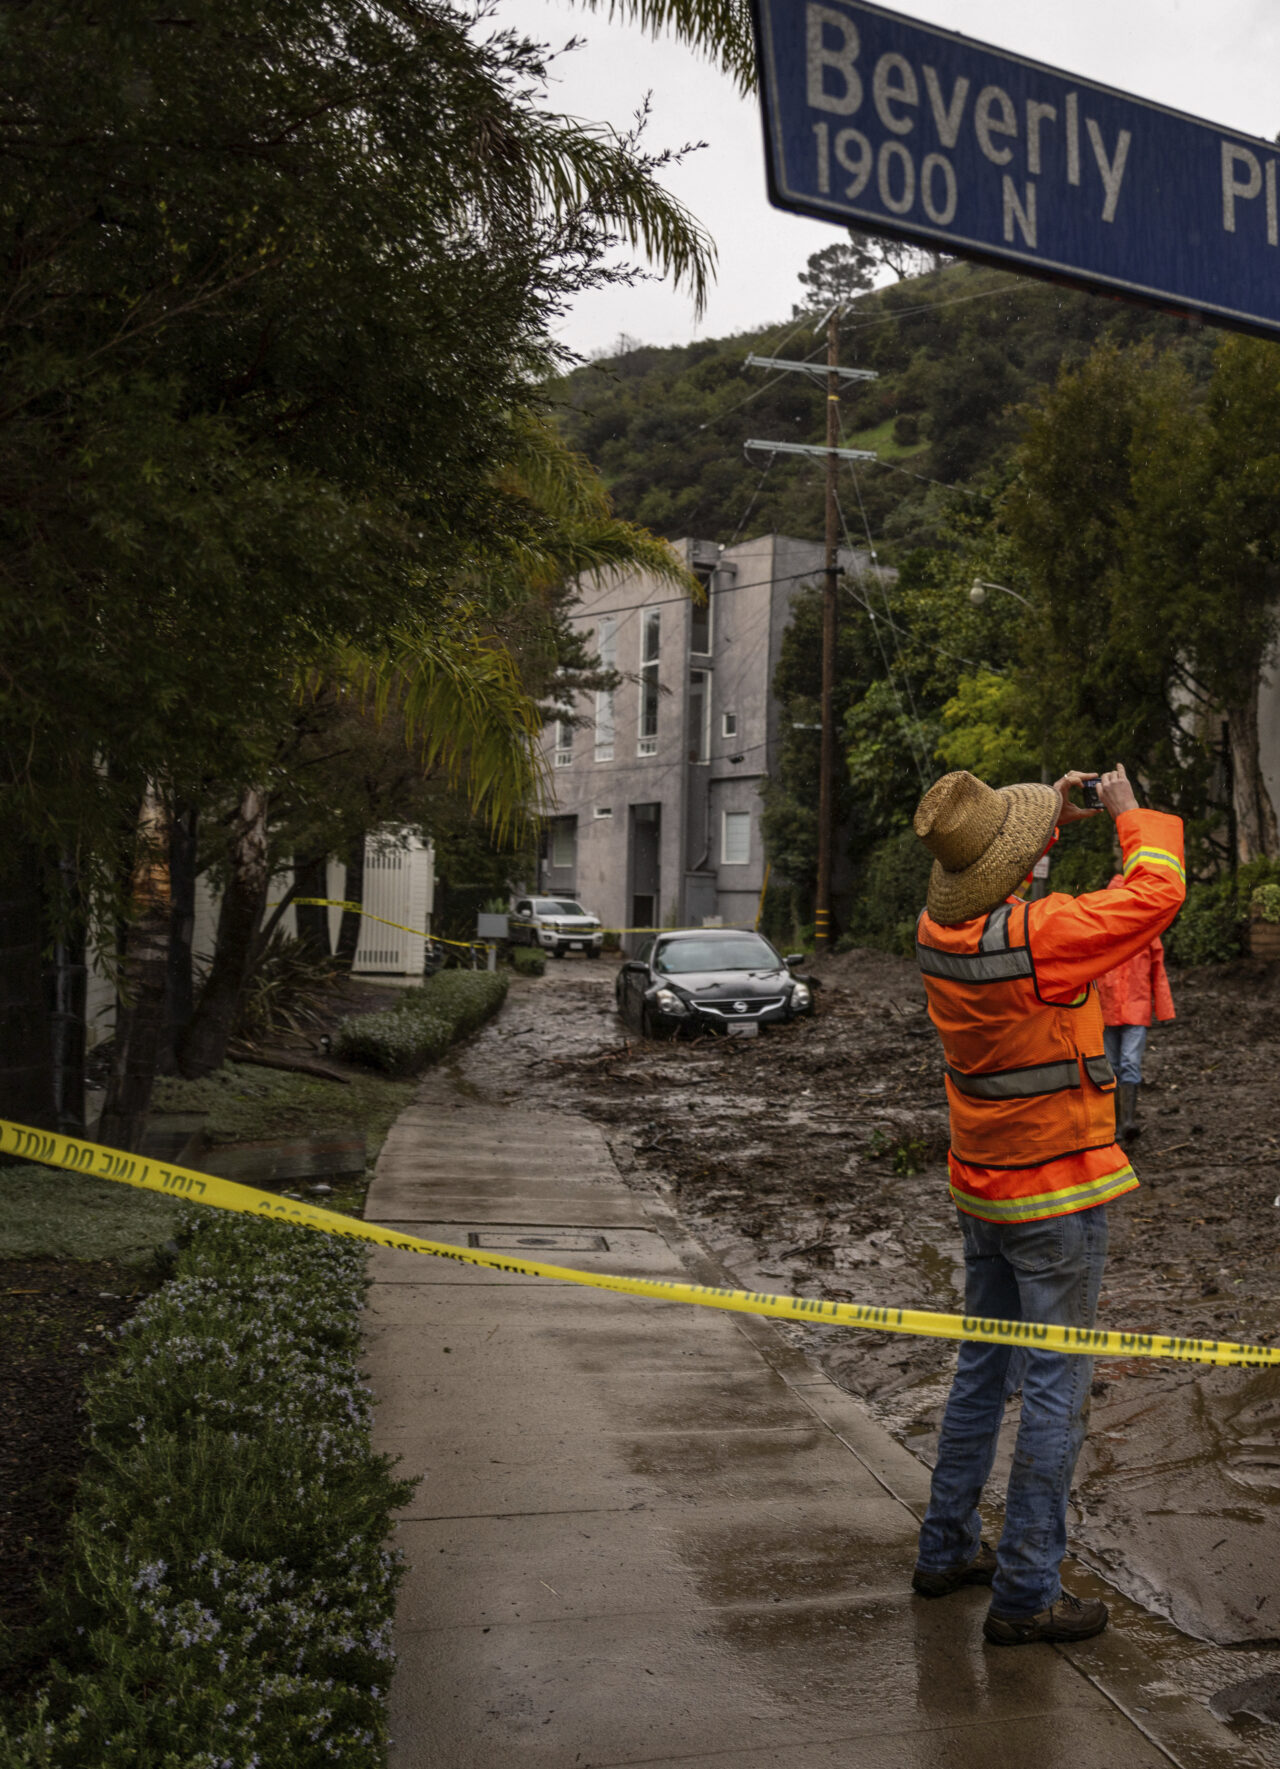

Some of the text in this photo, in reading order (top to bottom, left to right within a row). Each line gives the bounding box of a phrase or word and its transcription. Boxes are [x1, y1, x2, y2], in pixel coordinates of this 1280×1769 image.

[806, 5, 1278, 247] Beverly Pl
[812, 122, 1037, 248] 1900 N
